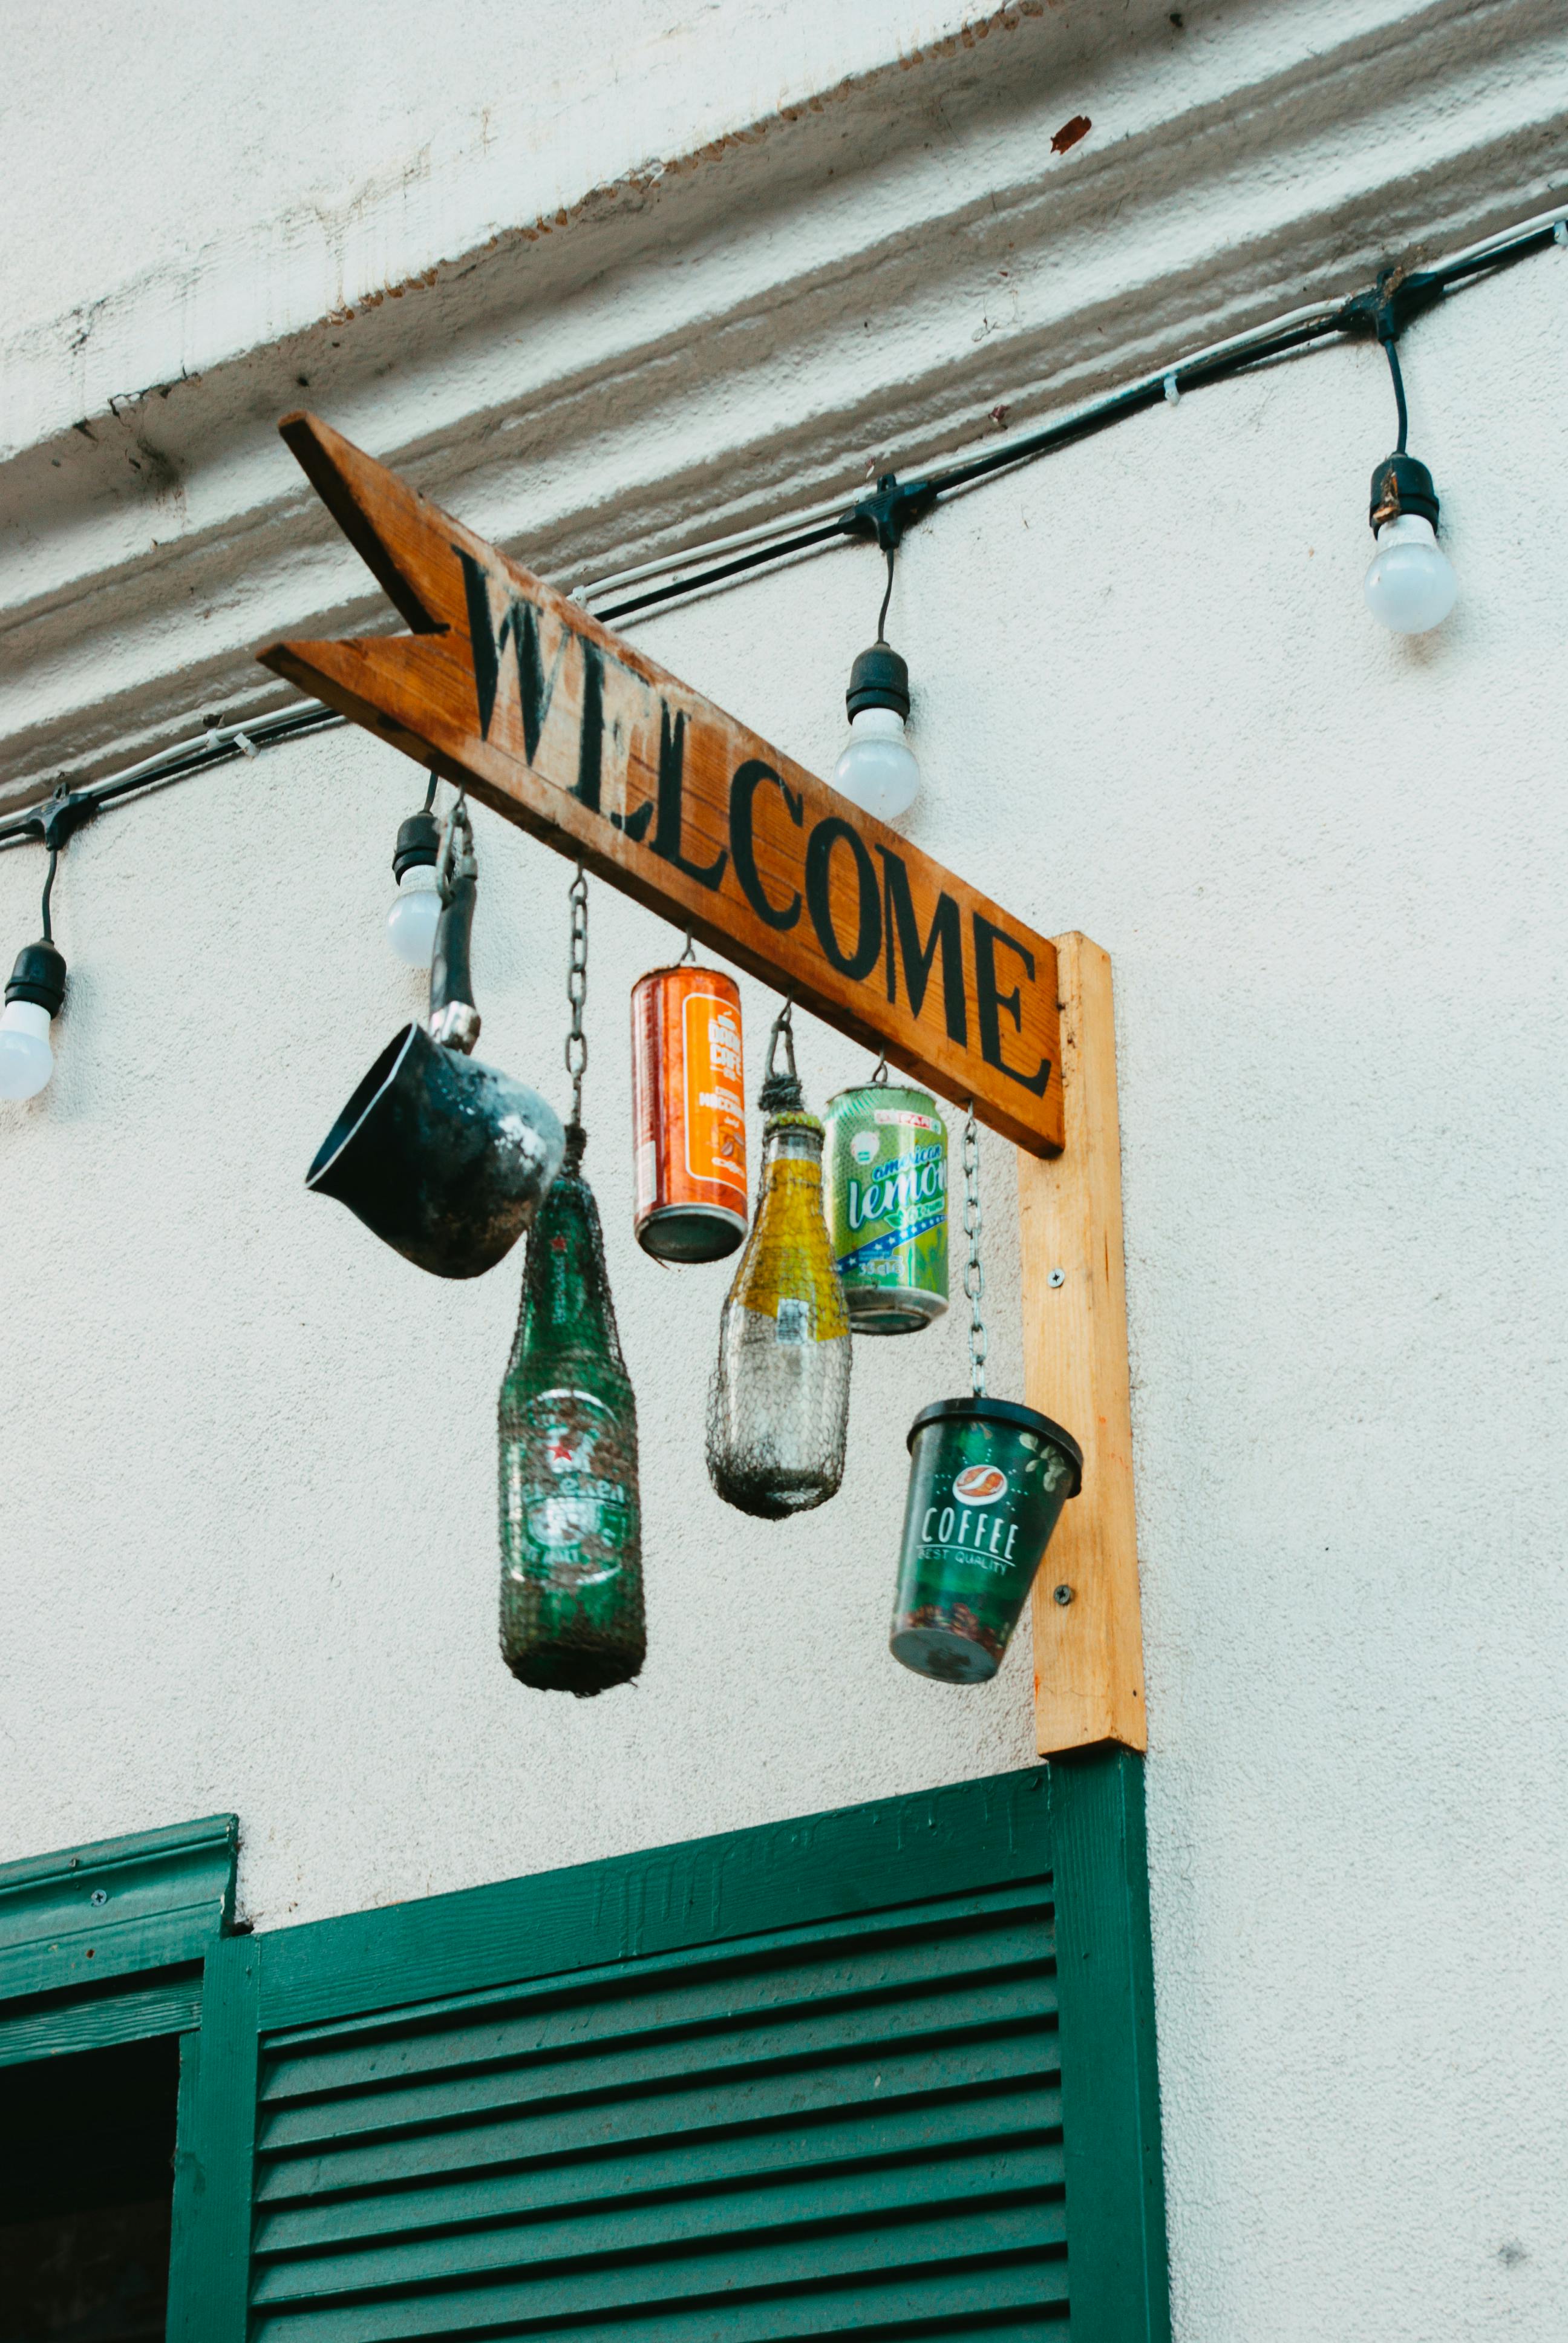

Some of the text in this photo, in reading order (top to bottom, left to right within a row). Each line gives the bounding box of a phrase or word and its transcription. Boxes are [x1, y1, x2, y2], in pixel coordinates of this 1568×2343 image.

[873, 1144, 941, 1180] american
[922, 1507, 1019, 1560] COFFEE
[918, 1548, 1008, 1576] BEST QUALITY
